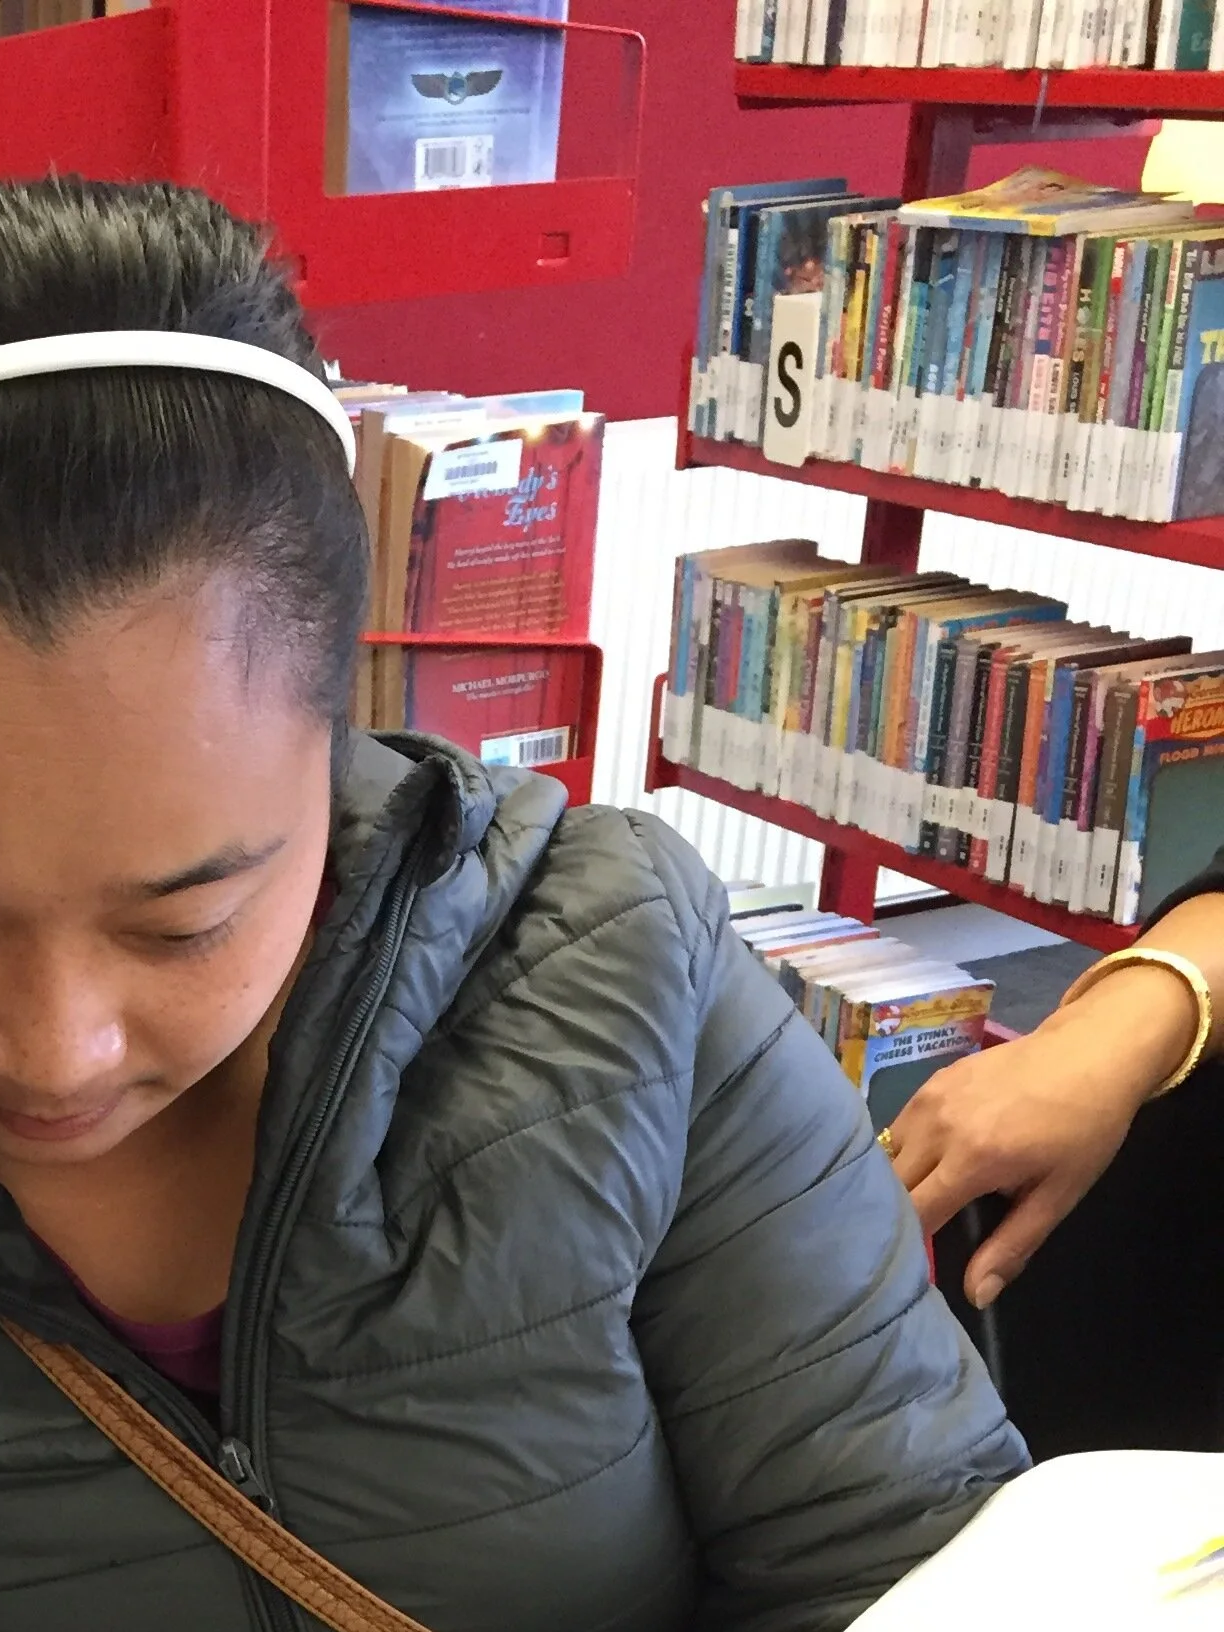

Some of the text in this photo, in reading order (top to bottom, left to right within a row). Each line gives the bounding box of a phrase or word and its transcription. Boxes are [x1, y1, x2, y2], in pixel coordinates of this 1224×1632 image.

[774, 341, 803, 427] S
[502, 496, 558, 533] Eyes
[874, 1036, 972, 1062] CHEESE VACATION
[893, 1027, 957, 1047] THE STINKY
